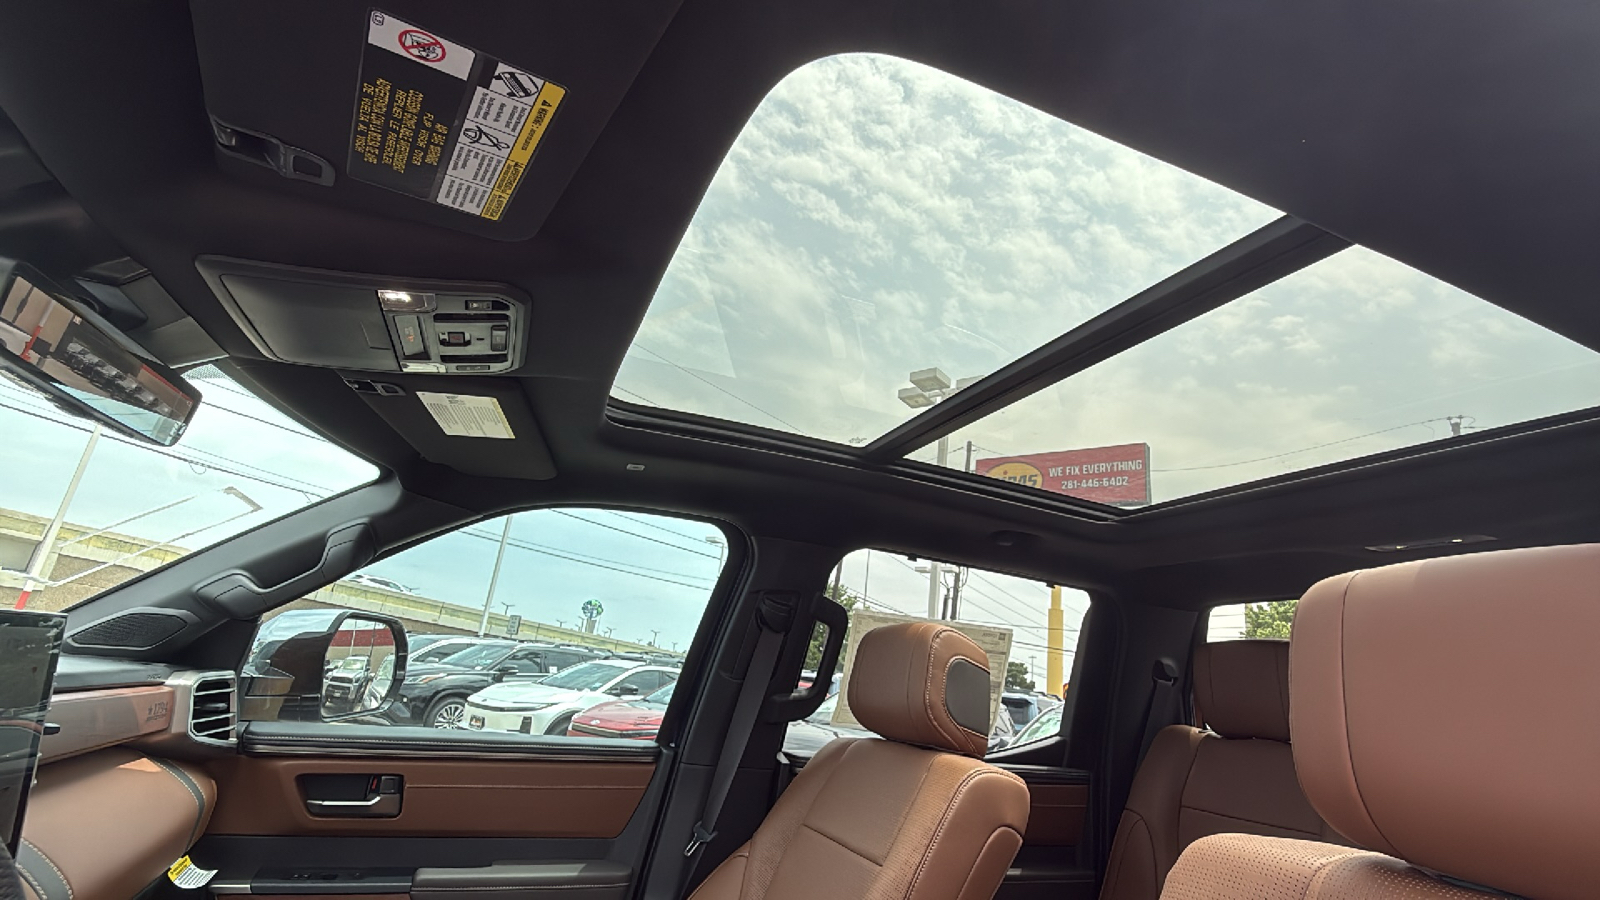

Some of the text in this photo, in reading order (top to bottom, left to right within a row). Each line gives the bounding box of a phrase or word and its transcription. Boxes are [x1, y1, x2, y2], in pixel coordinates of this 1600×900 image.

[362, 82, 374, 95] DE
[359, 97, 372, 122] VUELTA
[392, 88, 407, 119] REPLIER
[357, 122, 367, 132] AL
[389, 119, 400, 130] LE
[411, 111, 434, 166] FLIP VISOR OVER
[1048, 459, 1143, 477] WE FIX EVERYTHING
[1061, 476, 1129, 490] 281-446-6402
